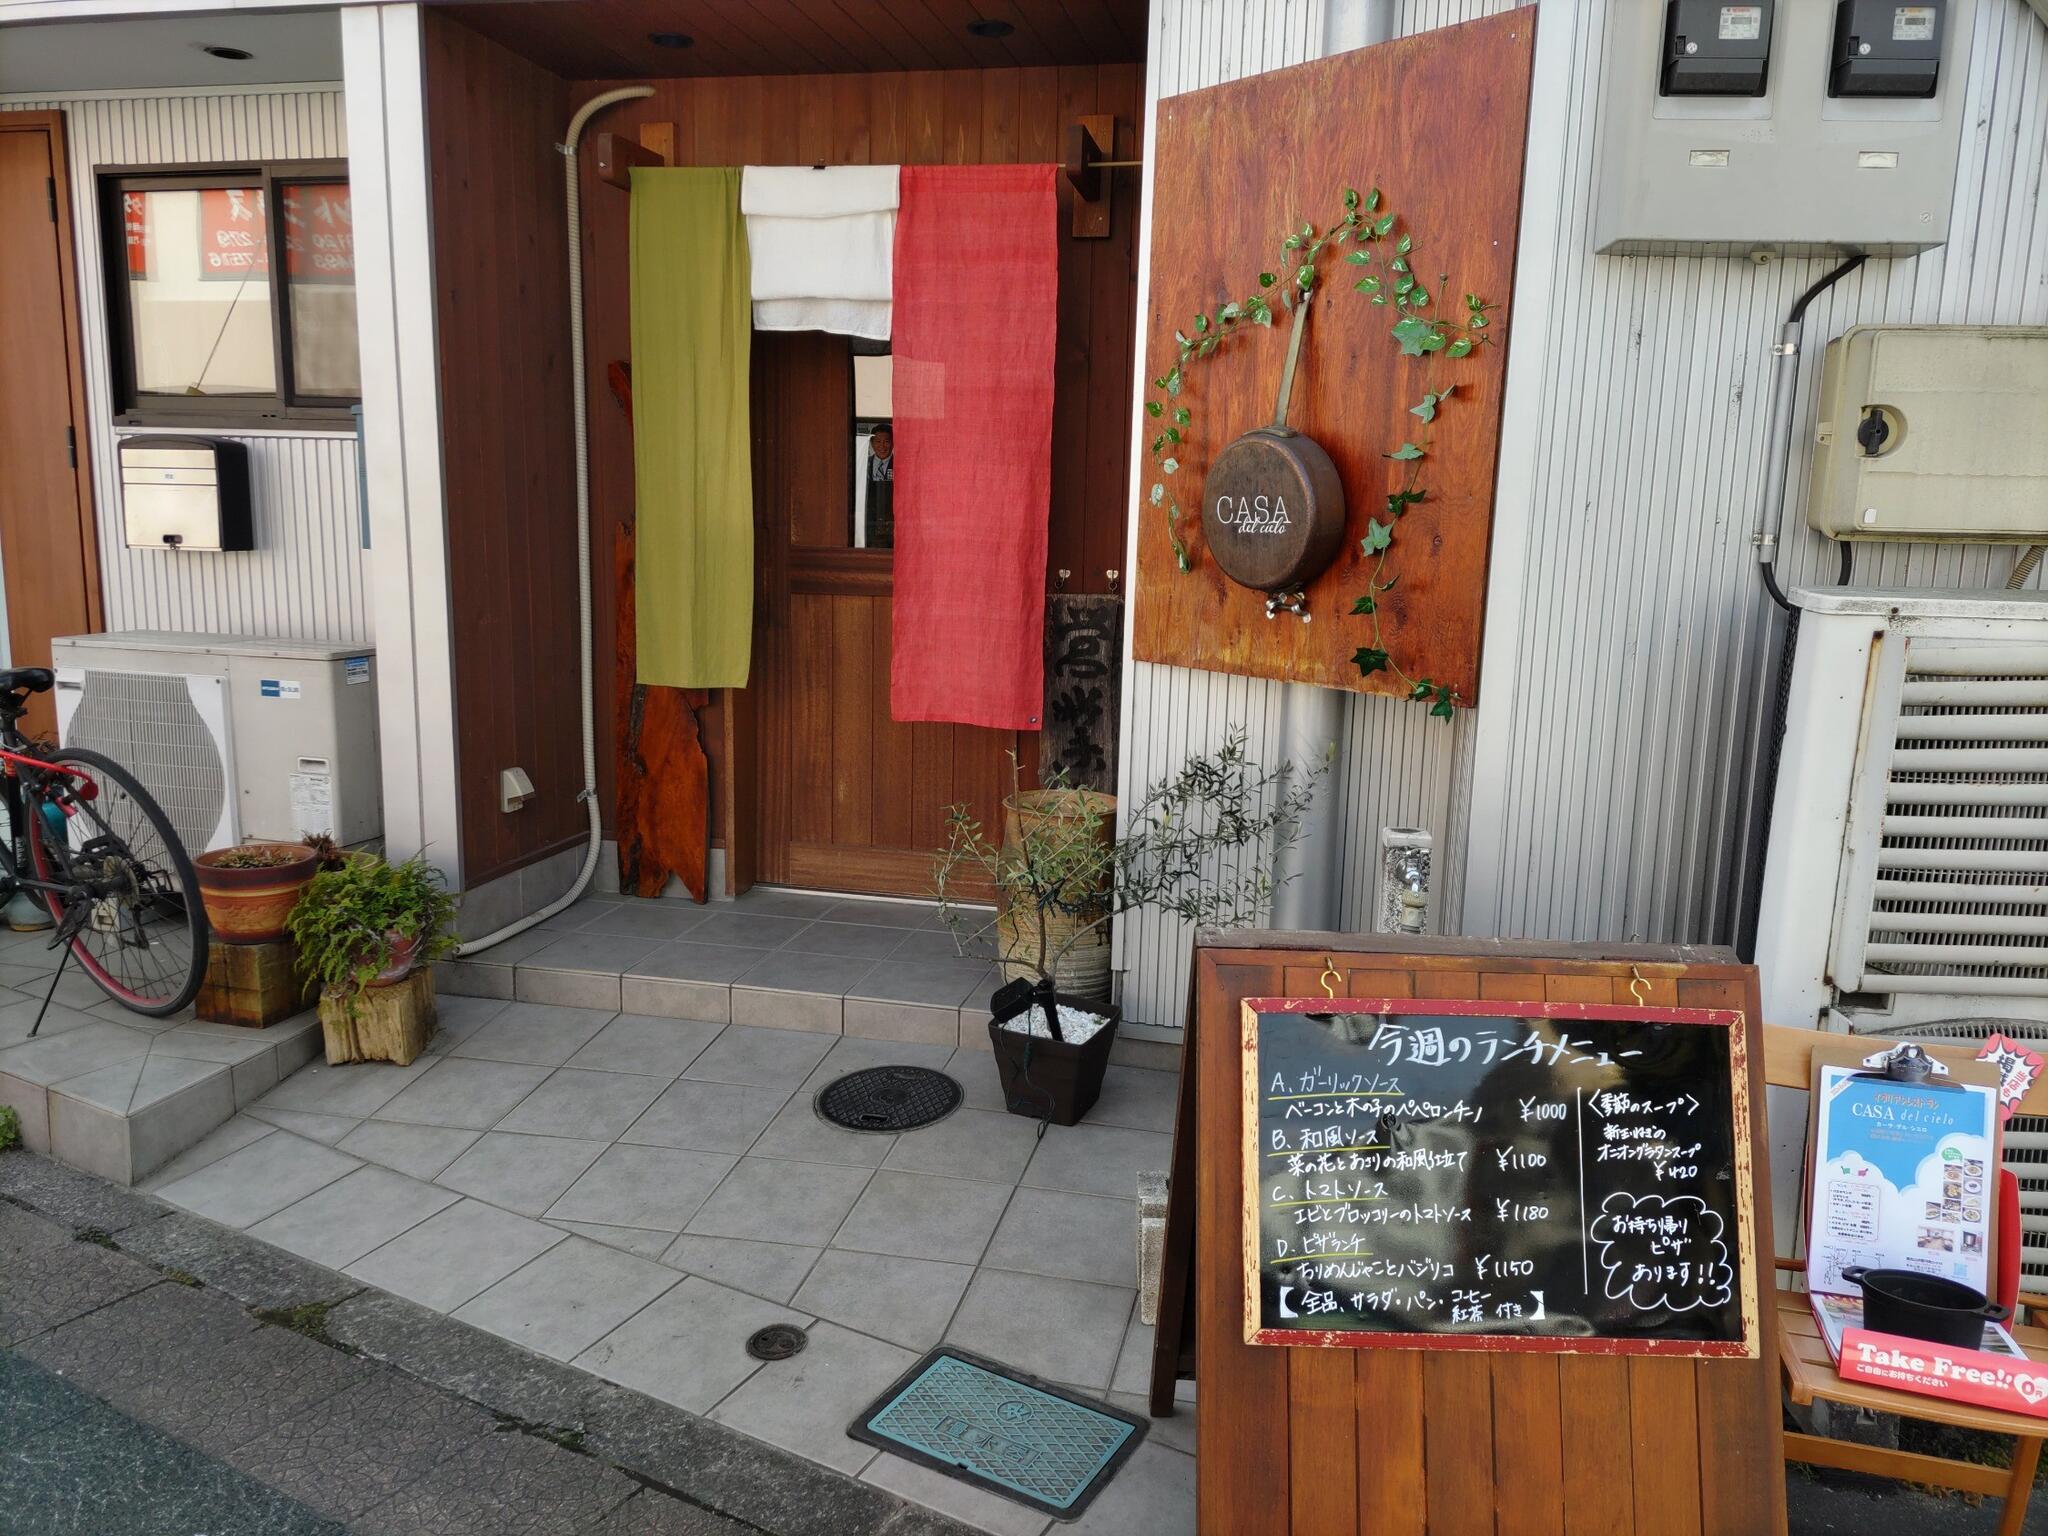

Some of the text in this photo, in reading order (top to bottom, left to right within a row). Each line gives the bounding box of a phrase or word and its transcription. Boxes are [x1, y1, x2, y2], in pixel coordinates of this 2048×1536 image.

[1216, 495, 1292, 524] CASA
[1238, 516, 1287, 535] del cielo
[1368, 1024, 1643, 1067] 今週のランチメニュー
[1519, 1096, 1568, 1122] ¥1000
[1852, 1103, 1955, 1126] CASA del cielo
[1496, 1145, 1547, 1172] ¥1100
[1597, 1142, 1702, 1162] オニオングラタンスープ
[1653, 1160, 1698, 1181] ¥420
[1294, 1198, 1549, 1225] エビとブロッコリーのトマトソース ¥1180
[1612, 1214, 1688, 1236] お持ち帰り
[1651, 1236, 1692, 1256] ピザ
[1297, 1254, 1533, 1281] ちりめんじゃことバジリコ ¥1150
[1452, 1305, 1483, 1324] 紅茶
[1856, 1364, 1949, 1388] ご自由にお持ちください
[1857, 1342, 2013, 1390] Take Free!!
